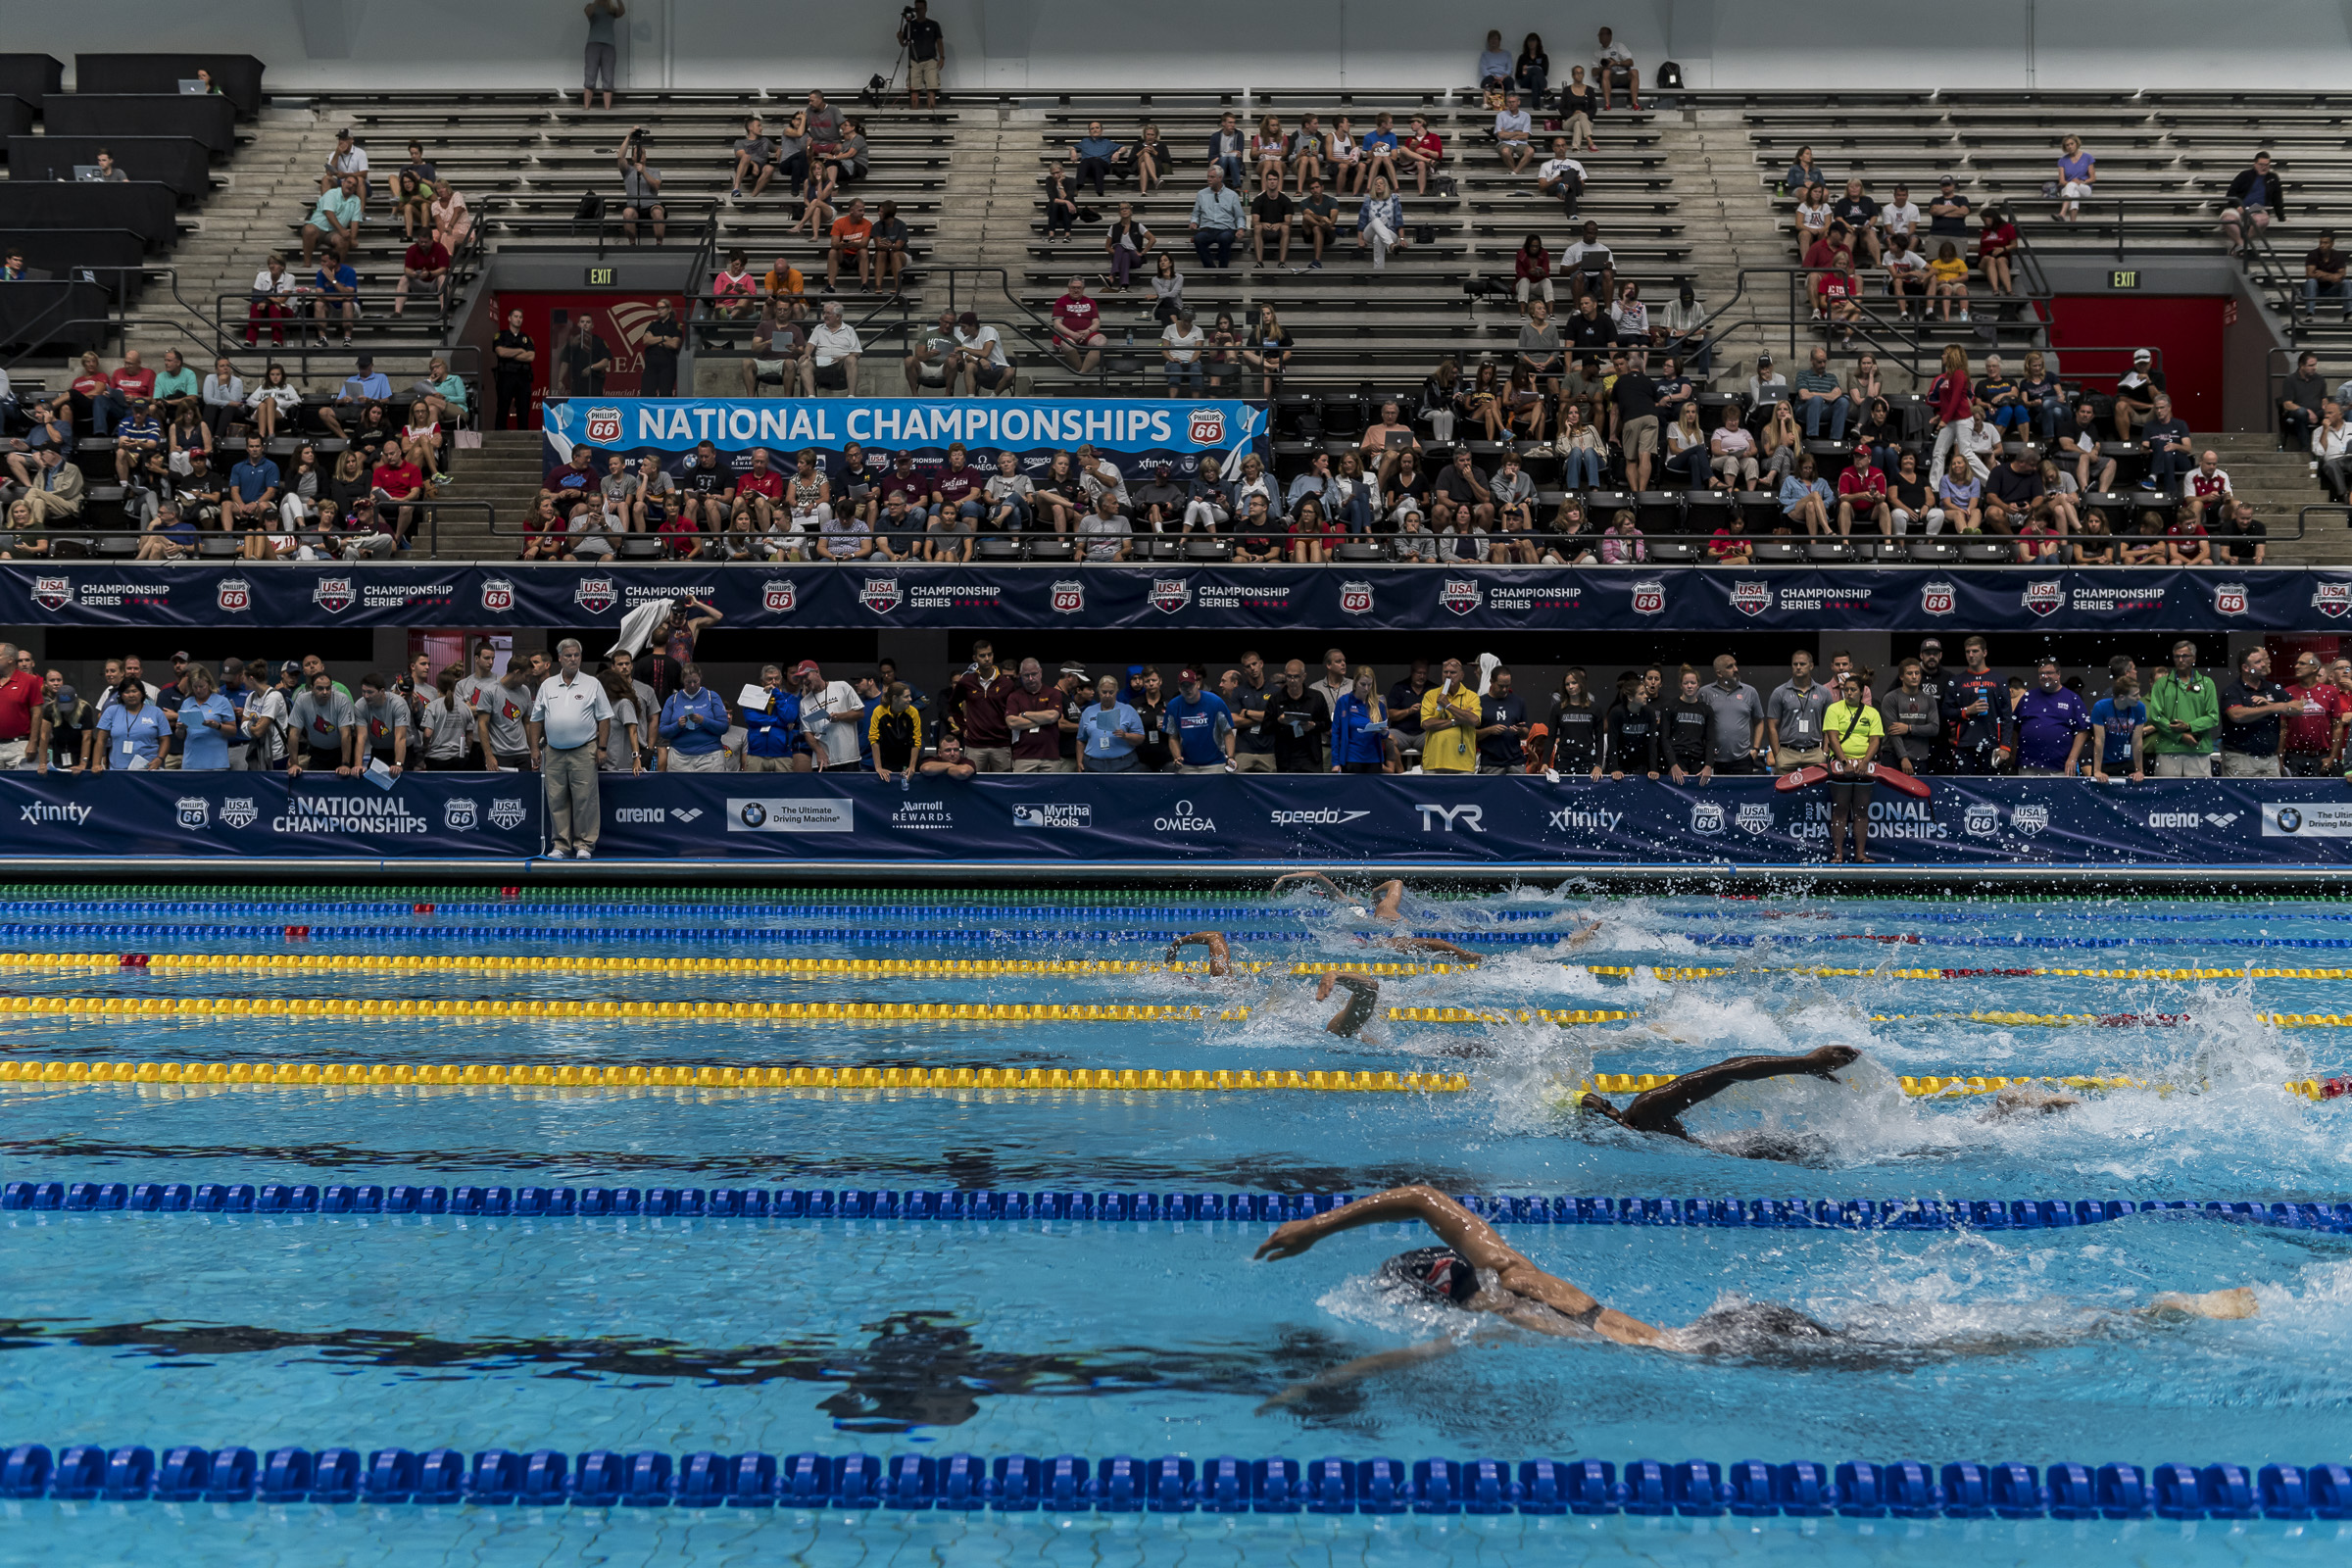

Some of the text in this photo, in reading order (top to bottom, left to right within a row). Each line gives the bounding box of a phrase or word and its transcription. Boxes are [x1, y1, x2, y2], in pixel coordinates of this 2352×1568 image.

[591, 269, 612, 284] EXIT
[2114, 270, 2136, 287] EXIT
[590, 422, 614, 437] 66
[638, 408, 1171, 442] NATIONAL CHAMPIONSHIPS
[1193, 424, 1217, 439] 66
[40, 580, 65, 591] USA
[80, 584, 170, 596] CHAMPIONSHIP
[322, 583, 346, 593] USA
[364, 585, 453, 596] CHAMPIONSHIP
[584, 583, 608, 593] USA
[869, 583, 893, 593] USA
[1158, 583, 1181, 593] USA
[1449, 584, 1473, 594] USA
[1740, 585, 1762, 595] USA
[2032, 585, 2055, 596] USA
[2323, 586, 2345, 596] USA
[625, 586, 715, 597] CHAMPIONSHIP
[910, 586, 1001, 597] CHAMPIONSHIP
[1199, 586, 1290, 597] CHAMPIONSHIP
[1491, 587, 1581, 599] CHAMPIONSHIP
[1781, 588, 1872, 599] CHAMPIONSHIP
[2073, 588, 2165, 599] CHAMPIONSHIP
[80, 596, 122, 606] SERIES
[223, 593, 243, 605] 66
[364, 597, 404, 607] SERIES
[487, 593, 508, 605] 66
[768, 594, 789, 605] 66
[910, 598, 951, 608] SERIES
[1057, 594, 1077, 606] 66
[1199, 598, 1240, 608] SERIES
[1347, 595, 1366, 607] 66
[1491, 599, 1531, 609] SERIES
[1638, 596, 1658, 608] 66
[1928, 597, 1948, 609] 66
[2222, 597, 2240, 609] 66
[1781, 600, 1821, 610] SERIES
[2073, 600, 2114, 610] SERIES
[228, 801, 249, 810] USA
[297, 797, 411, 816] NATIONAL
[497, 803, 517, 811] USA
[781, 806, 823, 814] The Ultimate
[900, 800, 943, 811] Marriott
[1744, 807, 1765, 815] USA
[20, 800, 93, 825] xfinity
[183, 810, 202, 822] 66
[615, 807, 665, 823] arena
[893, 812, 954, 822] REWARDS
[1044, 805, 1090, 819] Myrtha
[1270, 808, 1339, 826] speedo
[1816, 802, 1931, 821] NONAL
[2018, 808, 2039, 816] USA
[451, 811, 470, 824] 66
[773, 814, 803, 824] Driving
[1044, 815, 1080, 827] Pools
[1415, 804, 1484, 832] TYR
[1548, 806, 1624, 832] xfinity
[1697, 817, 1717, 829] 66
[1971, 817, 1990, 829] 66
[2148, 812, 2199, 828] arena
[272, 815, 427, 834] CHAMPIONSHIPS
[1153, 817, 1216, 832] OMEGA
[2309, 819, 2338, 829] Driving
[1788, 822, 1947, 838] CHAONSHIPS
